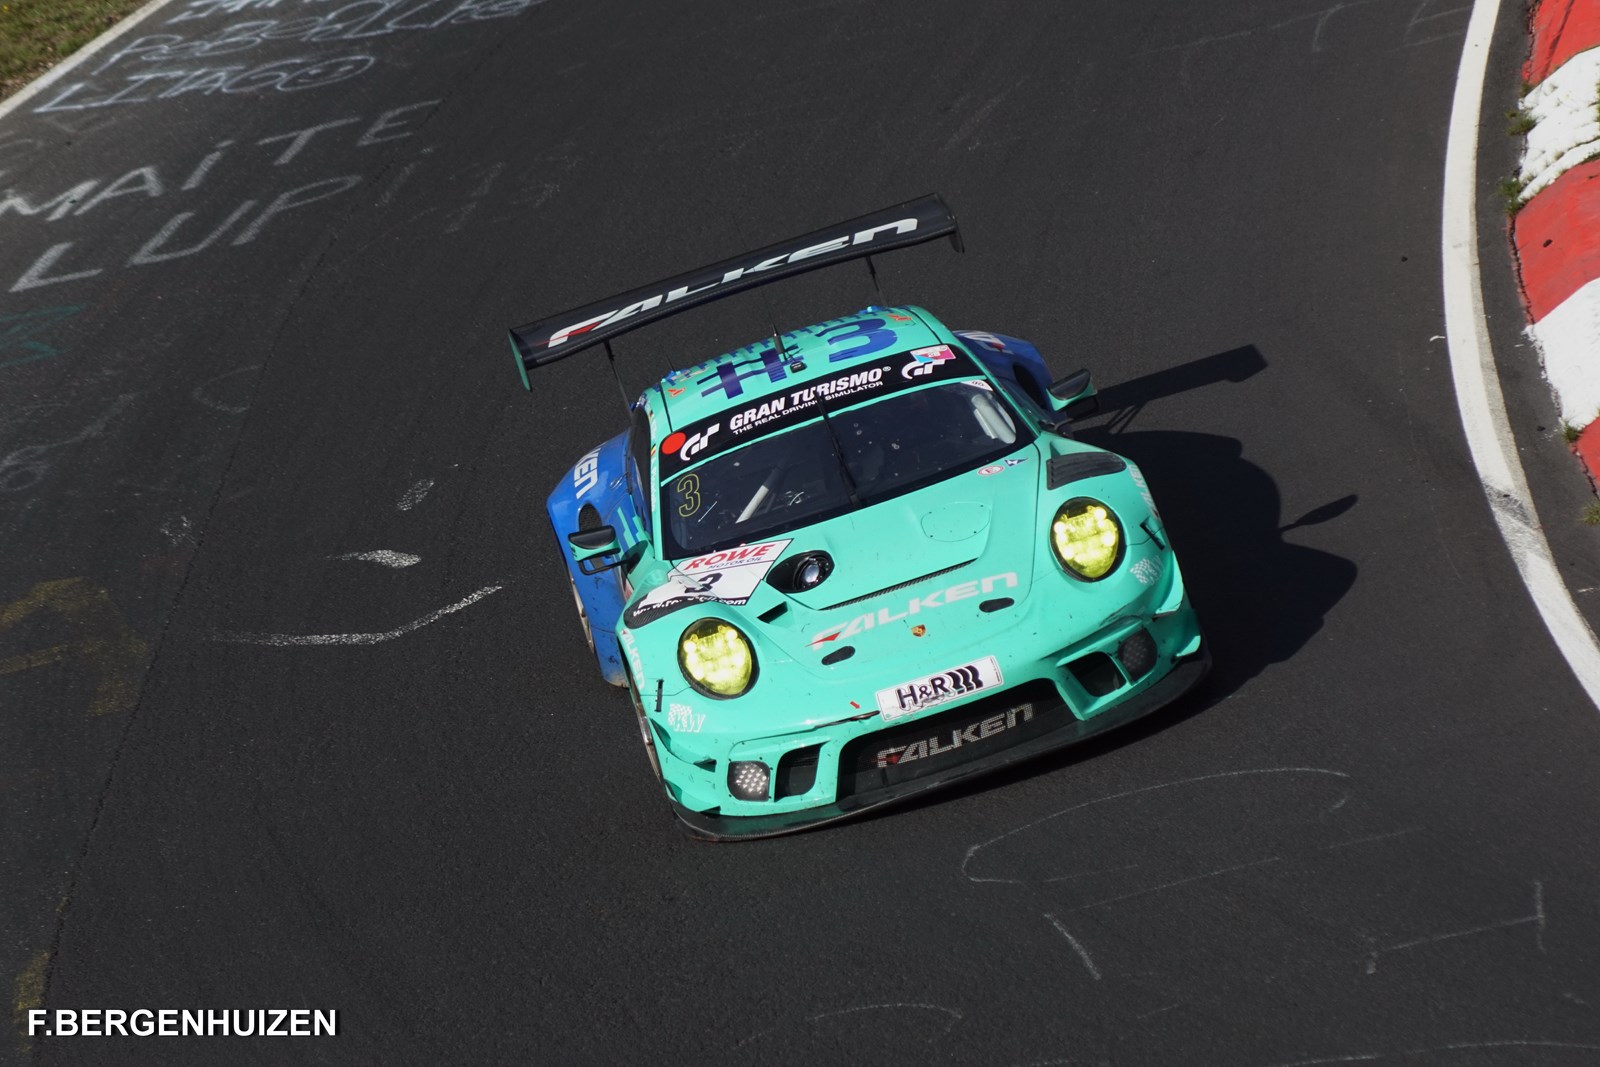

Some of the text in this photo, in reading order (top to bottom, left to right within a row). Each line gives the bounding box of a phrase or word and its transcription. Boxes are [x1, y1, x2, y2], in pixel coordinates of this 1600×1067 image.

[546, 218, 918, 348] FALKEN
[729, 397, 786, 431] GRAN
[732, 381, 884, 436] THE REAL DRIVIN SIMULATOR
[677, 473, 701, 518] 3
[683, 544, 776, 571] ROWE
[707, 559, 746, 570] MOTOR
[684, 572, 723, 594] 3
[809, 571, 1019, 651] FALKEN
[896, 676, 949, 709] H&R
[876, 703, 1034, 768] FALKEN
